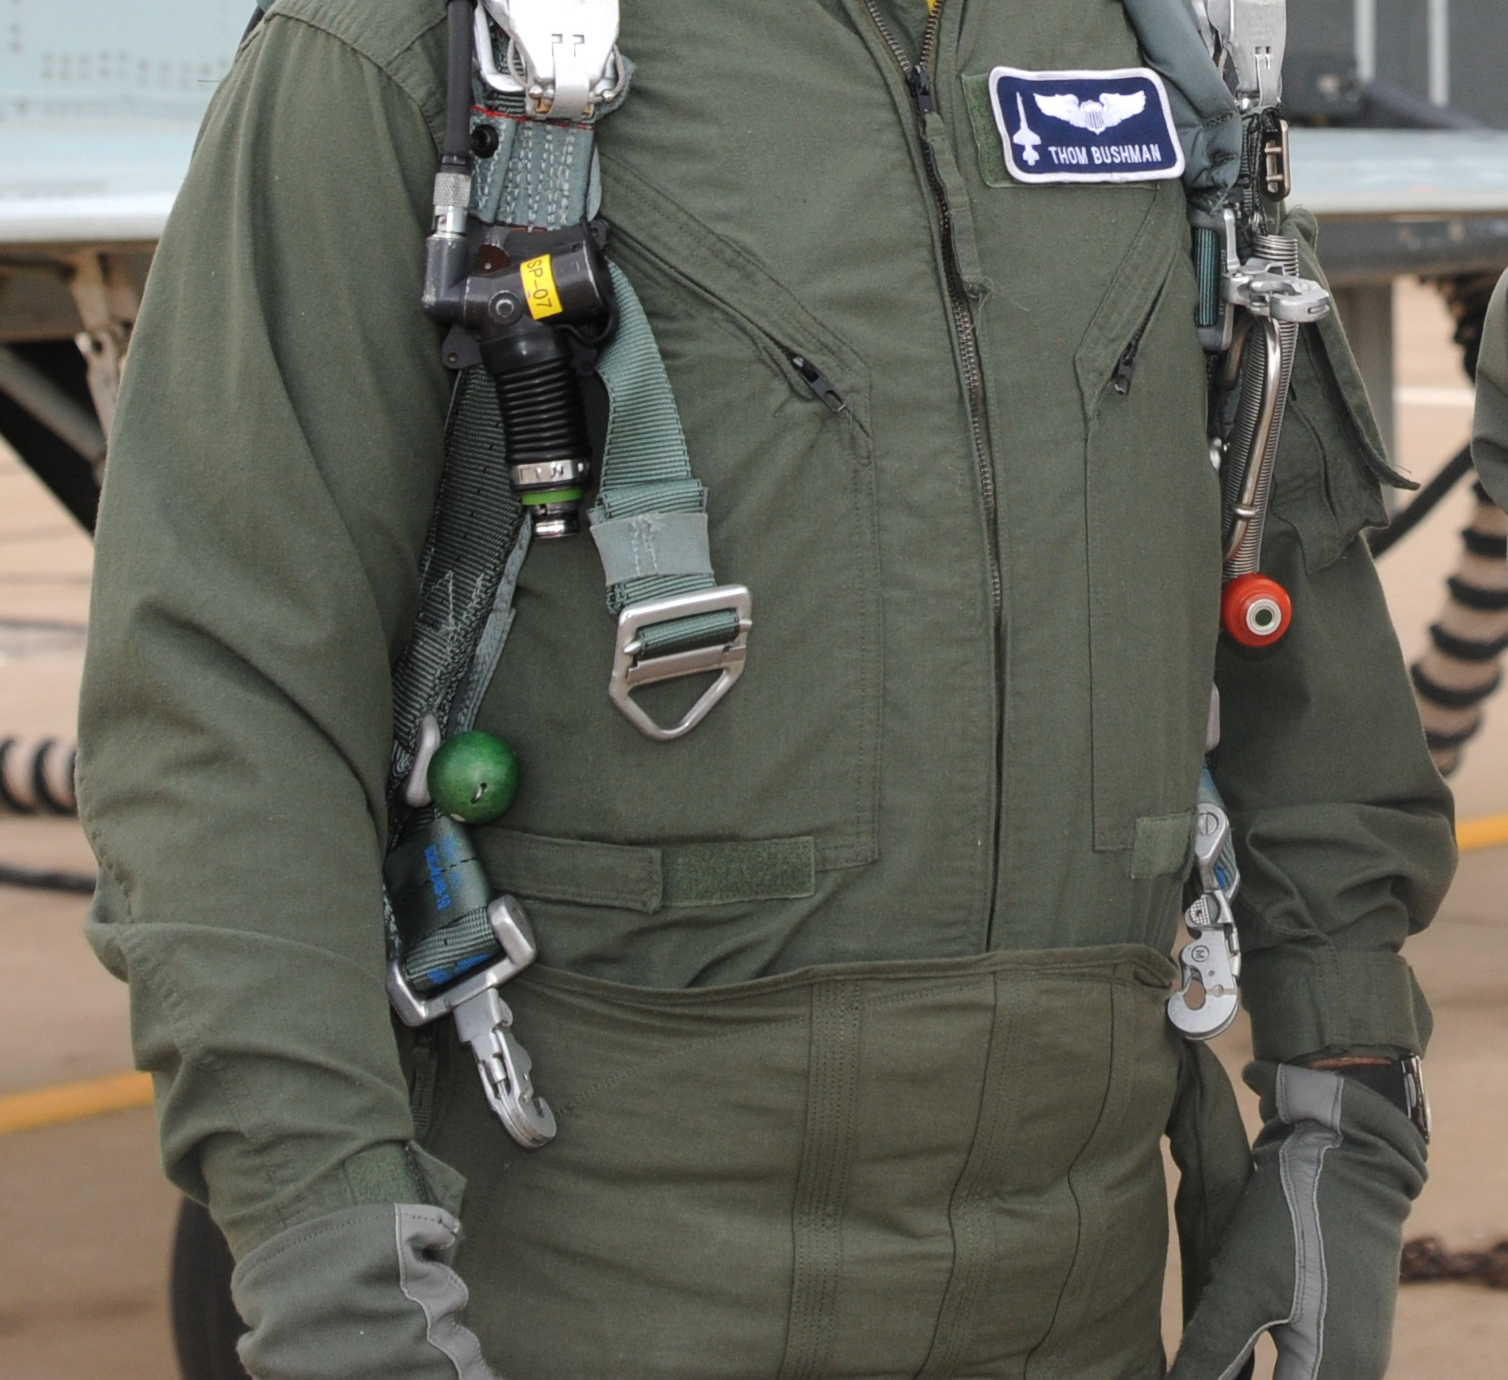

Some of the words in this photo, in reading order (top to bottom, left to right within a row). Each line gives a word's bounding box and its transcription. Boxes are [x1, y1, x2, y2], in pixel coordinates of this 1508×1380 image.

[1048, 145, 1089, 165] THOM
[1090, 143, 1162, 165] BUSHMAN
[526, 259, 553, 308] SP-07
